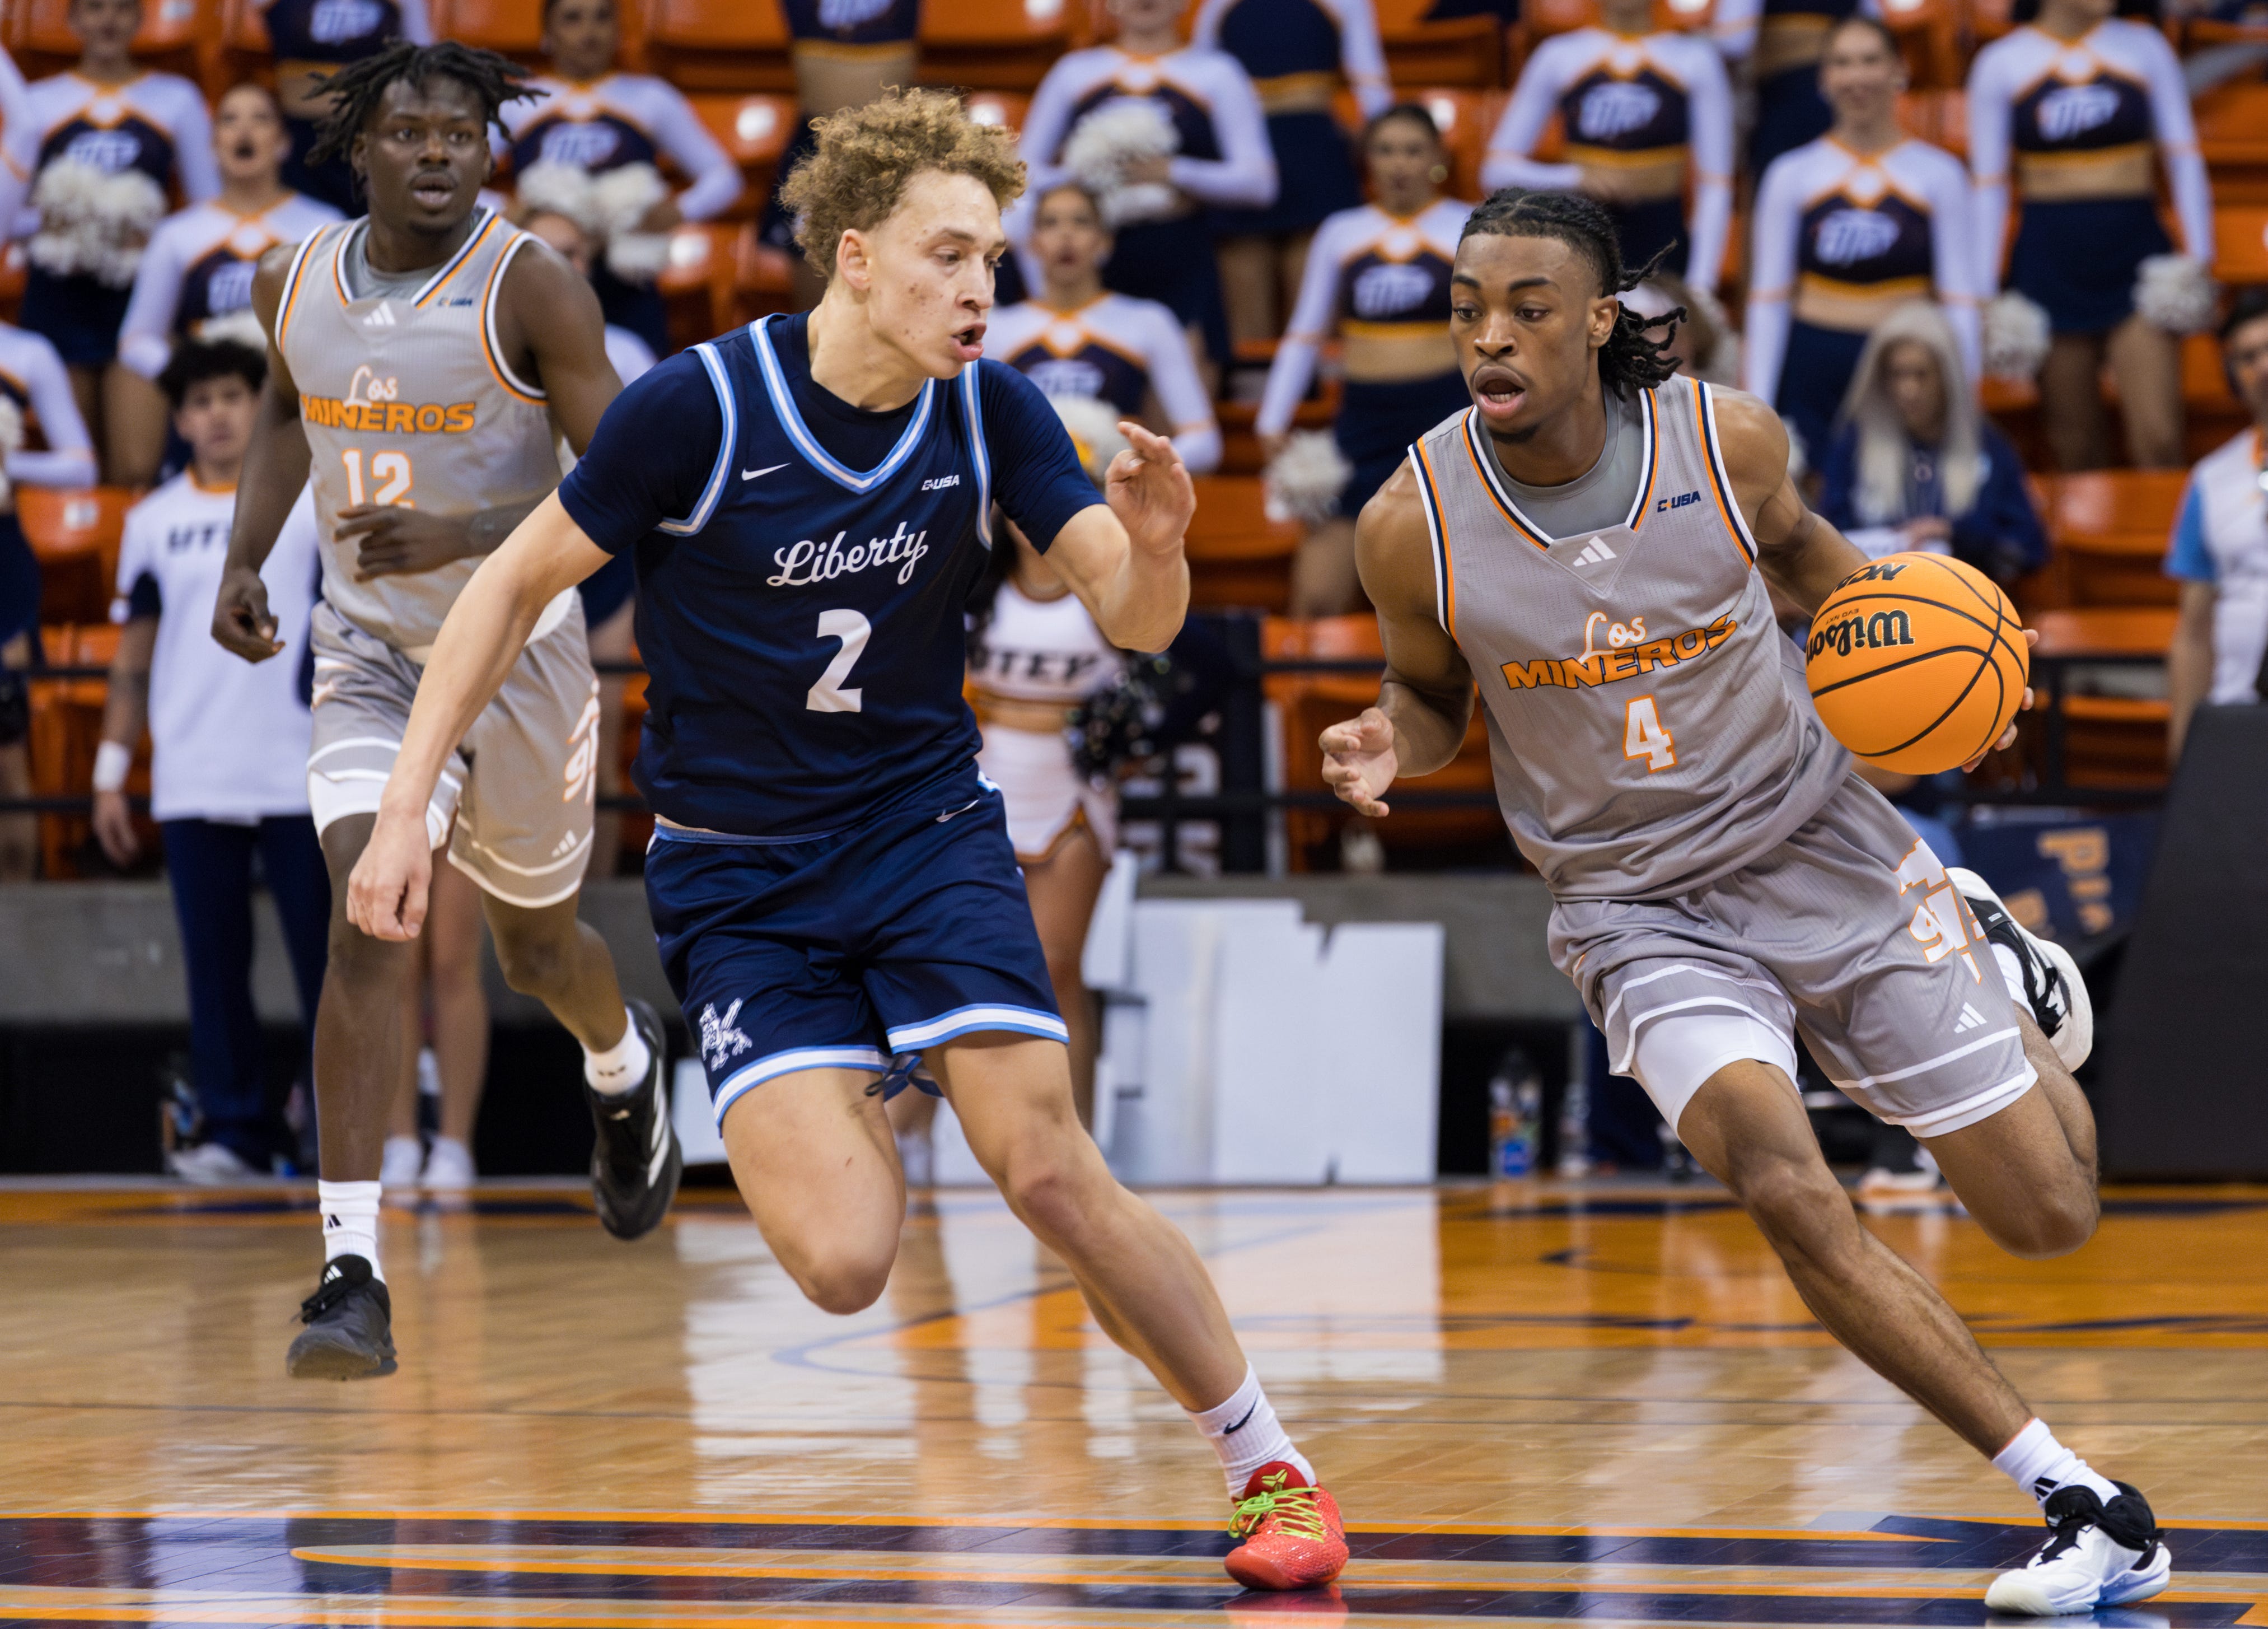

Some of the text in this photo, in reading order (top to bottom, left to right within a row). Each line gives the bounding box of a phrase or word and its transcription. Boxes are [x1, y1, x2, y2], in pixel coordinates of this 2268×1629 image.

[300, 394, 476, 433] MINEROS
[343, 365, 398, 408] Los
[342, 448, 415, 509] 12
[766, 521, 929, 587] Liberty
[806, 609, 872, 712] 2
[1500, 611, 1737, 689] MINEROS
[1577, 611, 1647, 665] Los
[1807, 609, 1915, 666] Wilson
[1623, 694, 1677, 773] 4
